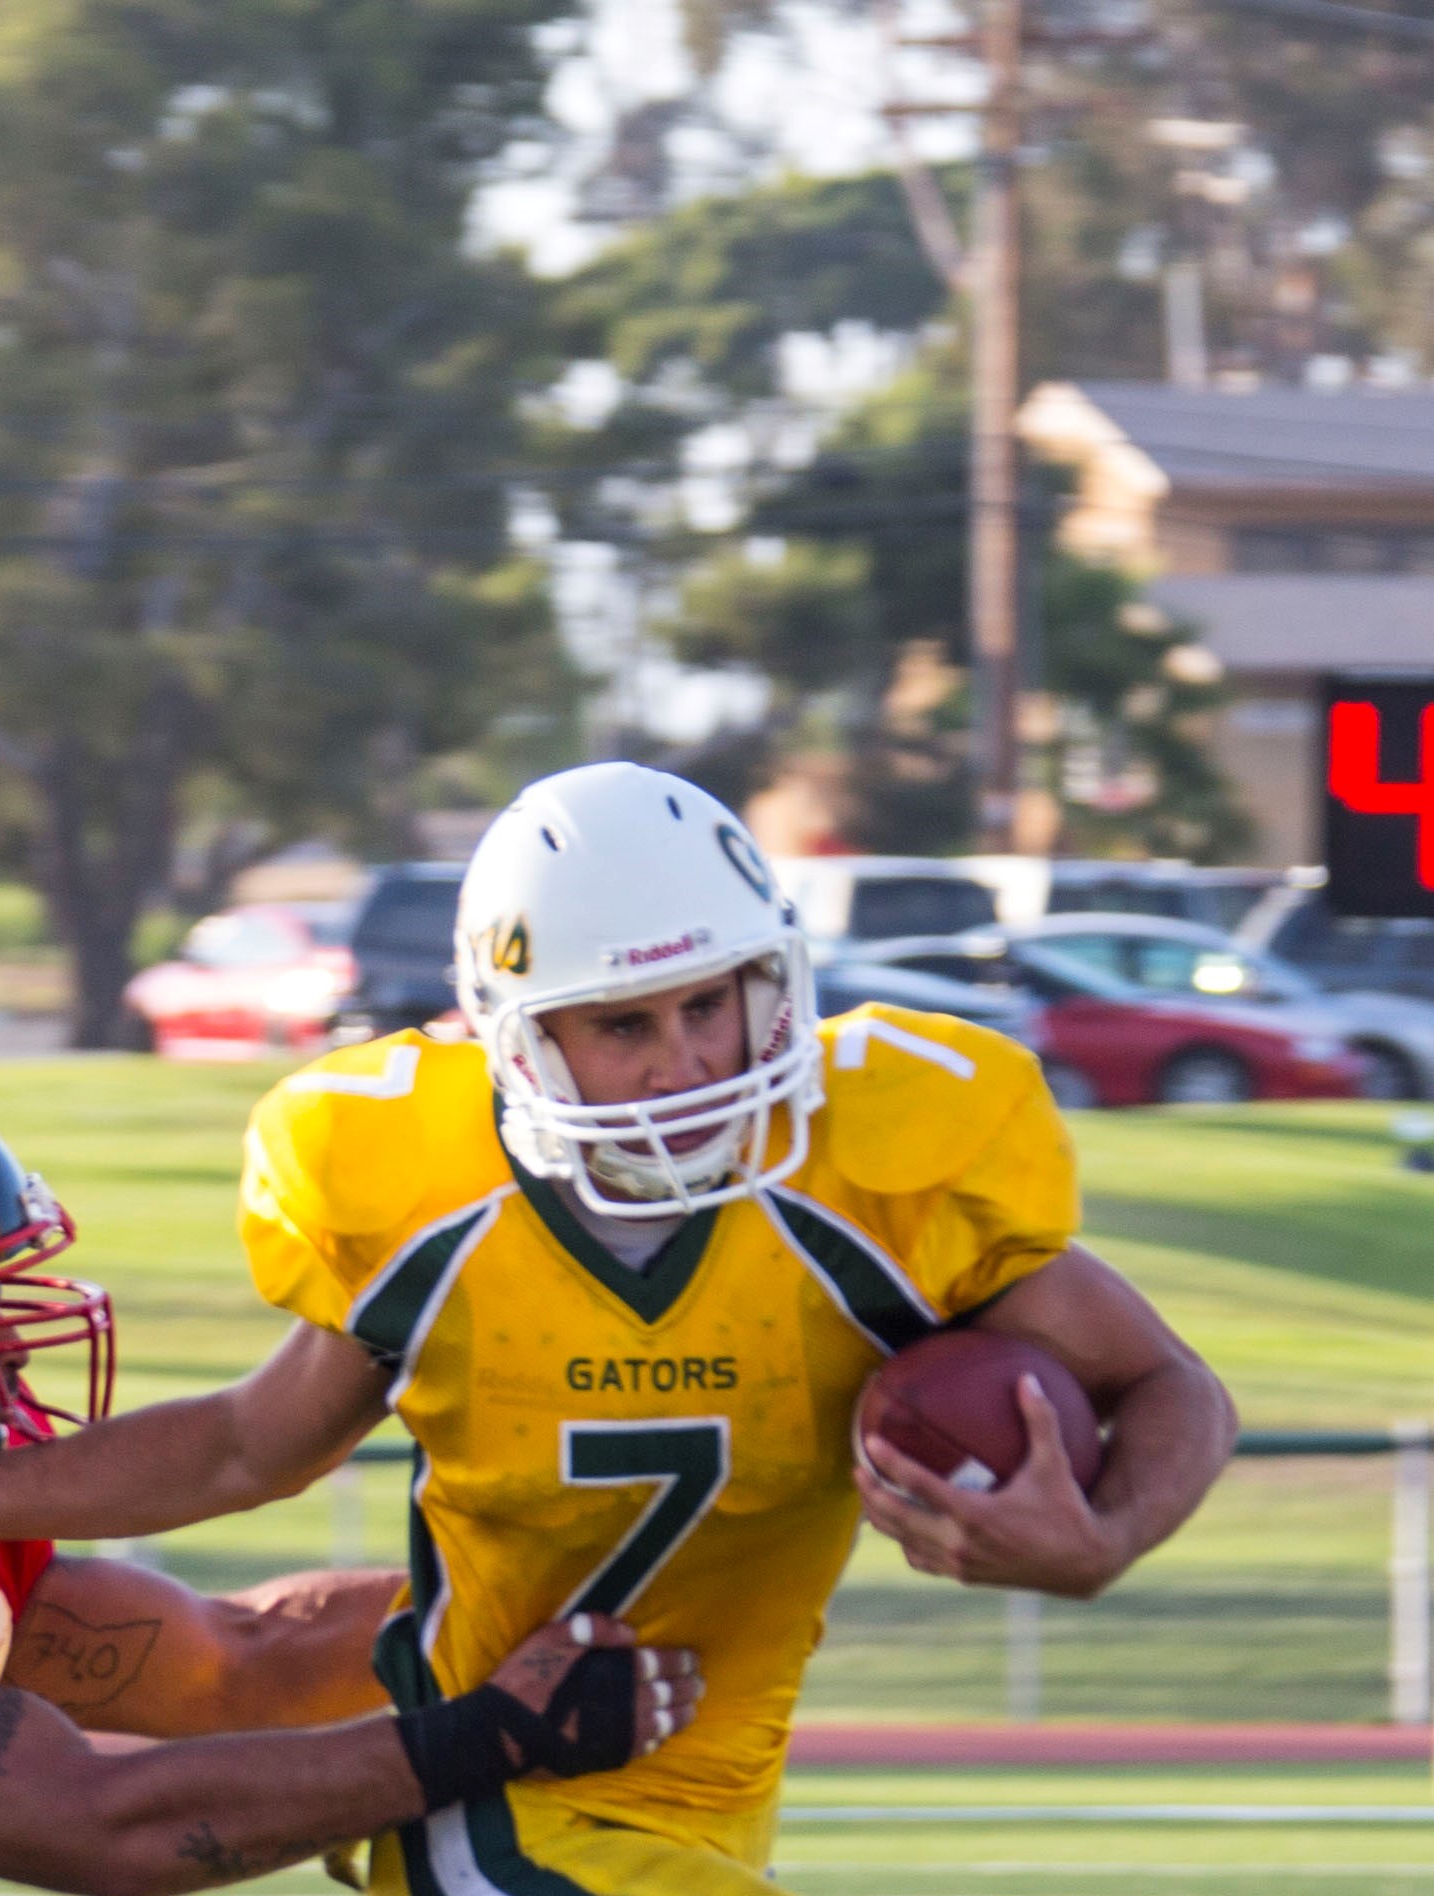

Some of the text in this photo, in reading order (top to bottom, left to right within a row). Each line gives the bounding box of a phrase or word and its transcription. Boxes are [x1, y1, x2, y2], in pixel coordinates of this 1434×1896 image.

[1328, 700, 1434, 891] 4
[566, 1357, 738, 1391] GATORS
[555, 1415, 731, 1623] 7
